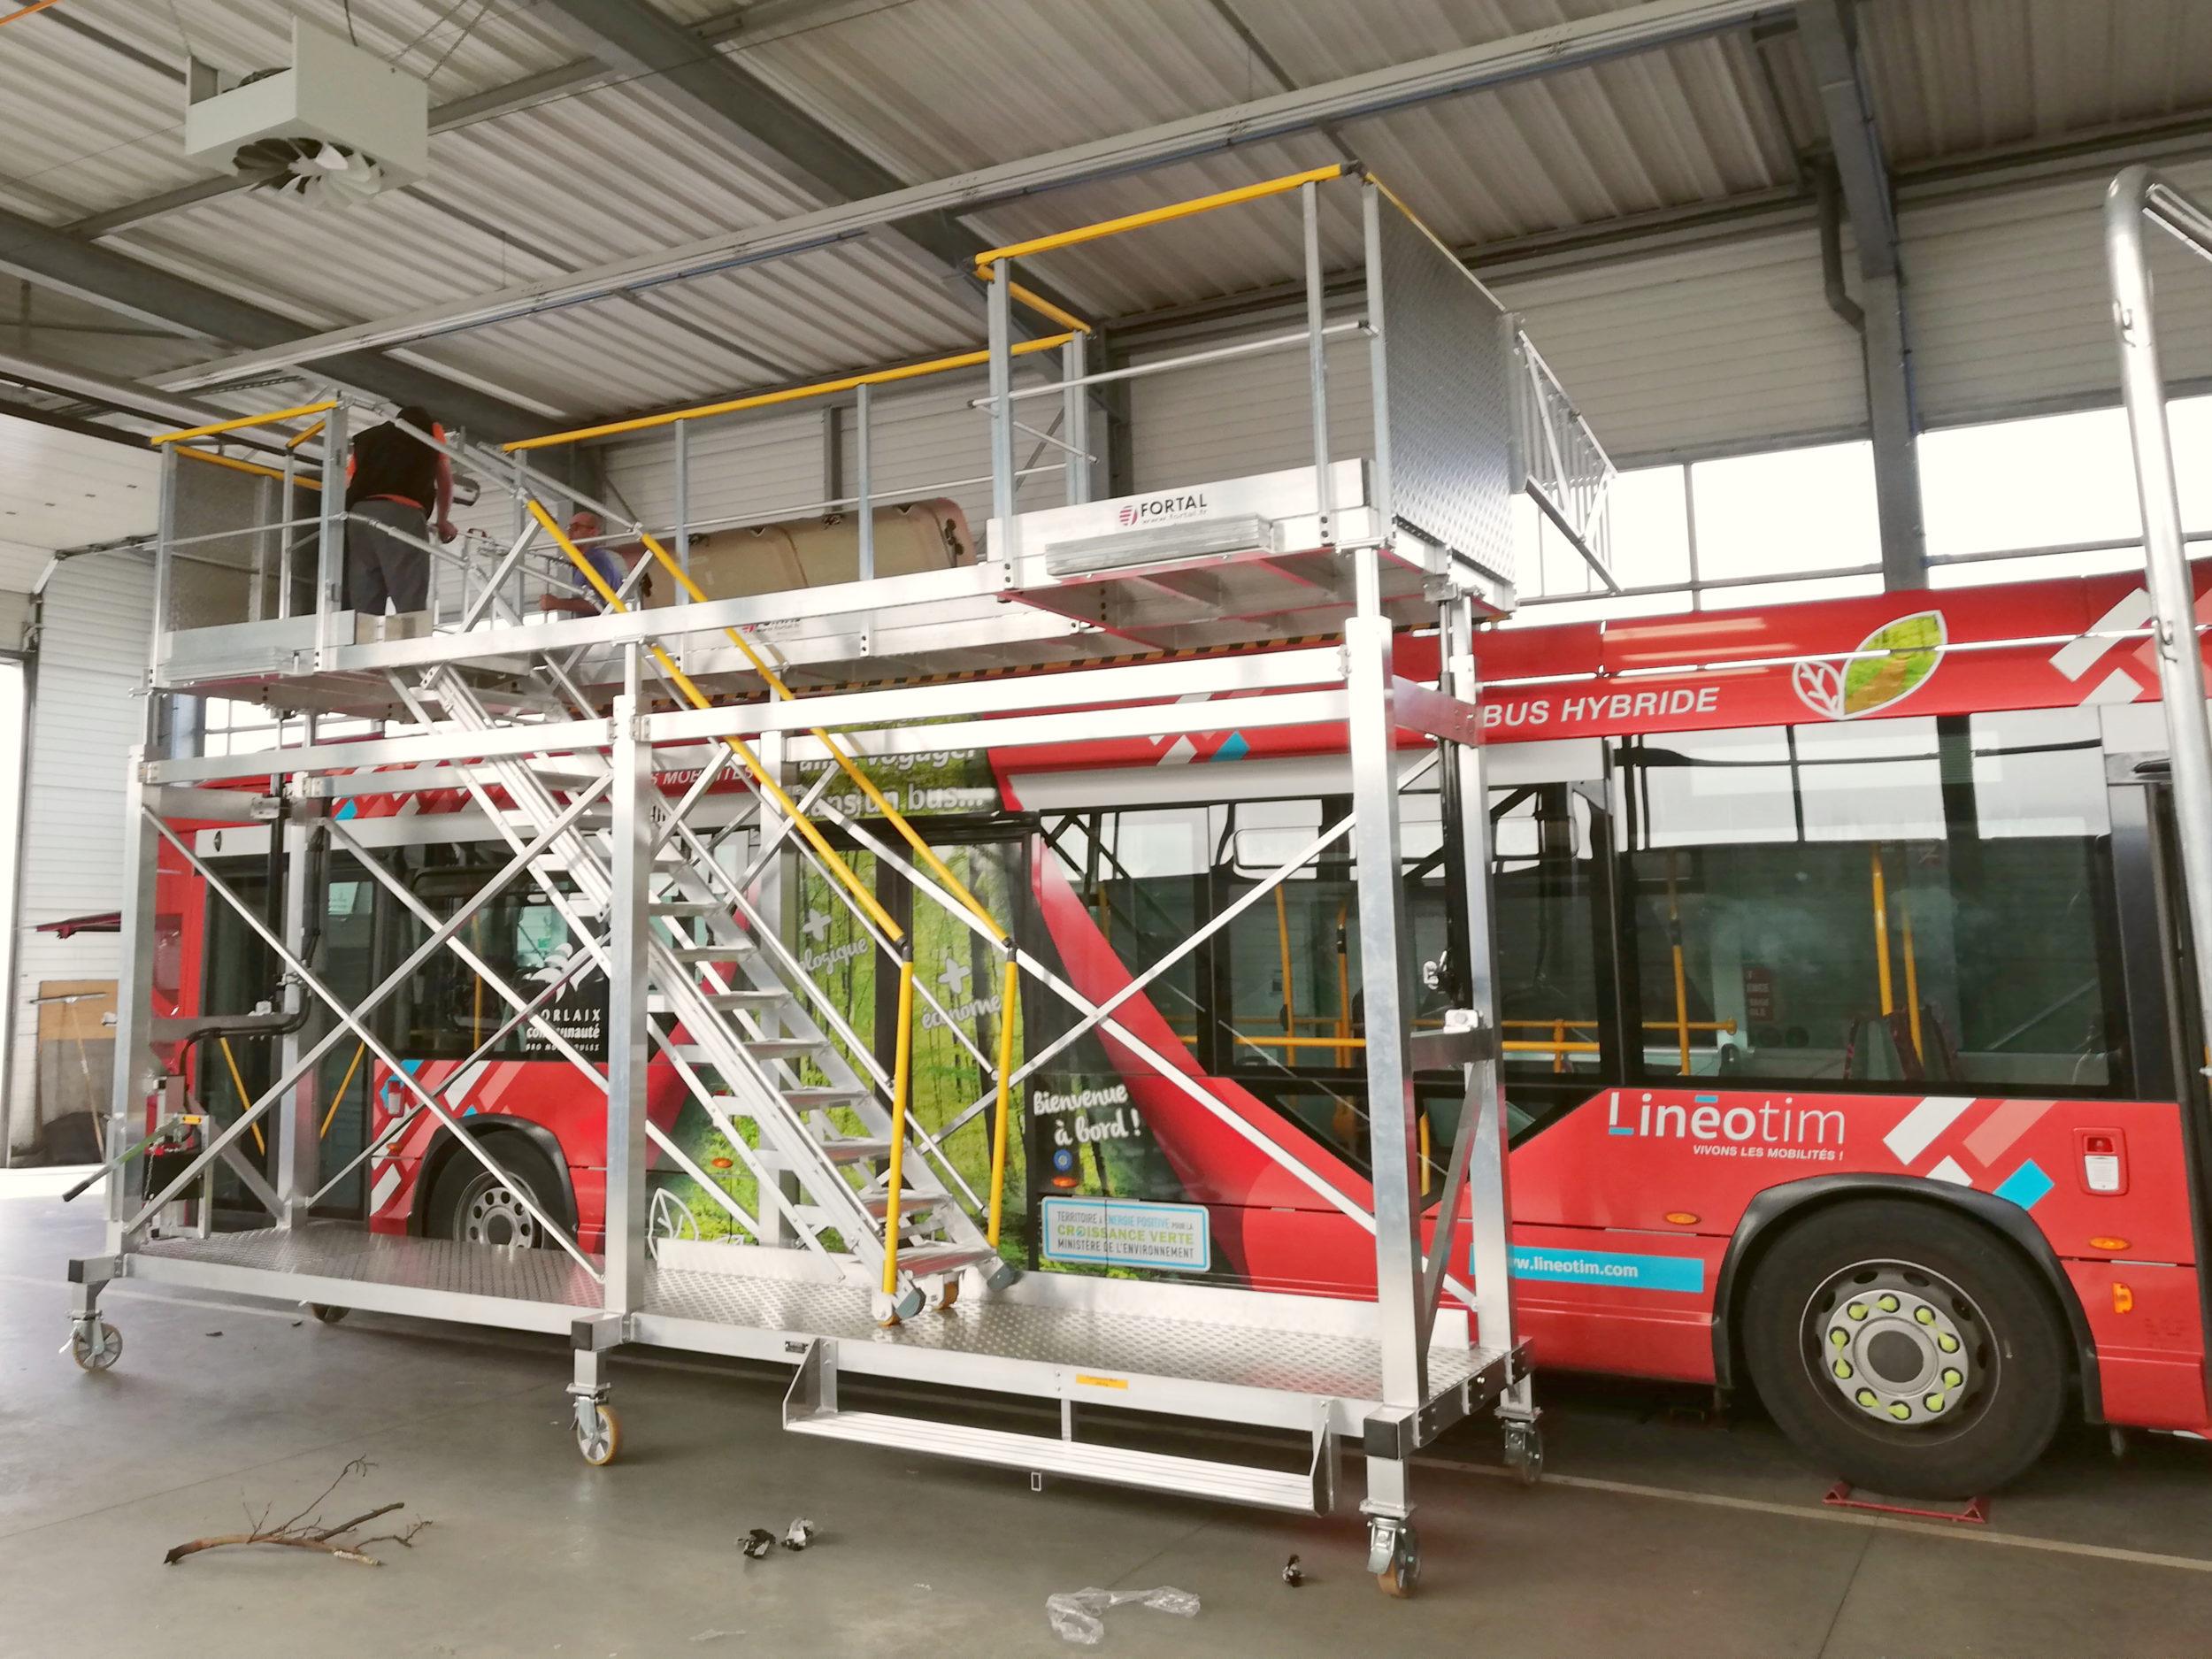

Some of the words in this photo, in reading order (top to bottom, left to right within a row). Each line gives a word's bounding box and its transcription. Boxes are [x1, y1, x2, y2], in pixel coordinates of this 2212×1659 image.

[1141, 494, 1208, 517] FORTAL
[1483, 701, 1549, 728] BUS
[1560, 687, 1720, 723] HYBRIDE
[1033, 1083, 1128, 1116] Bienvenue
[1054, 1118, 1073, 1146] à
[1075, 1107, 1129, 1143] bord
[1130, 1107, 1141, 1136] !
[1693, 1145, 1737, 1156] VIVONS
[1740, 1147, 1763, 1158] LES
[1767, 1148, 1835, 1161] MOBILITÉS
[1056, 1210, 1097, 1225] TERRITOIRE
[1057, 1224, 1145, 1242] CROISSANCE
[1149, 1231, 1194, 1246] VERTE
[1116, 1241, 1194, 1259] L'ENVIRONNEMENT
